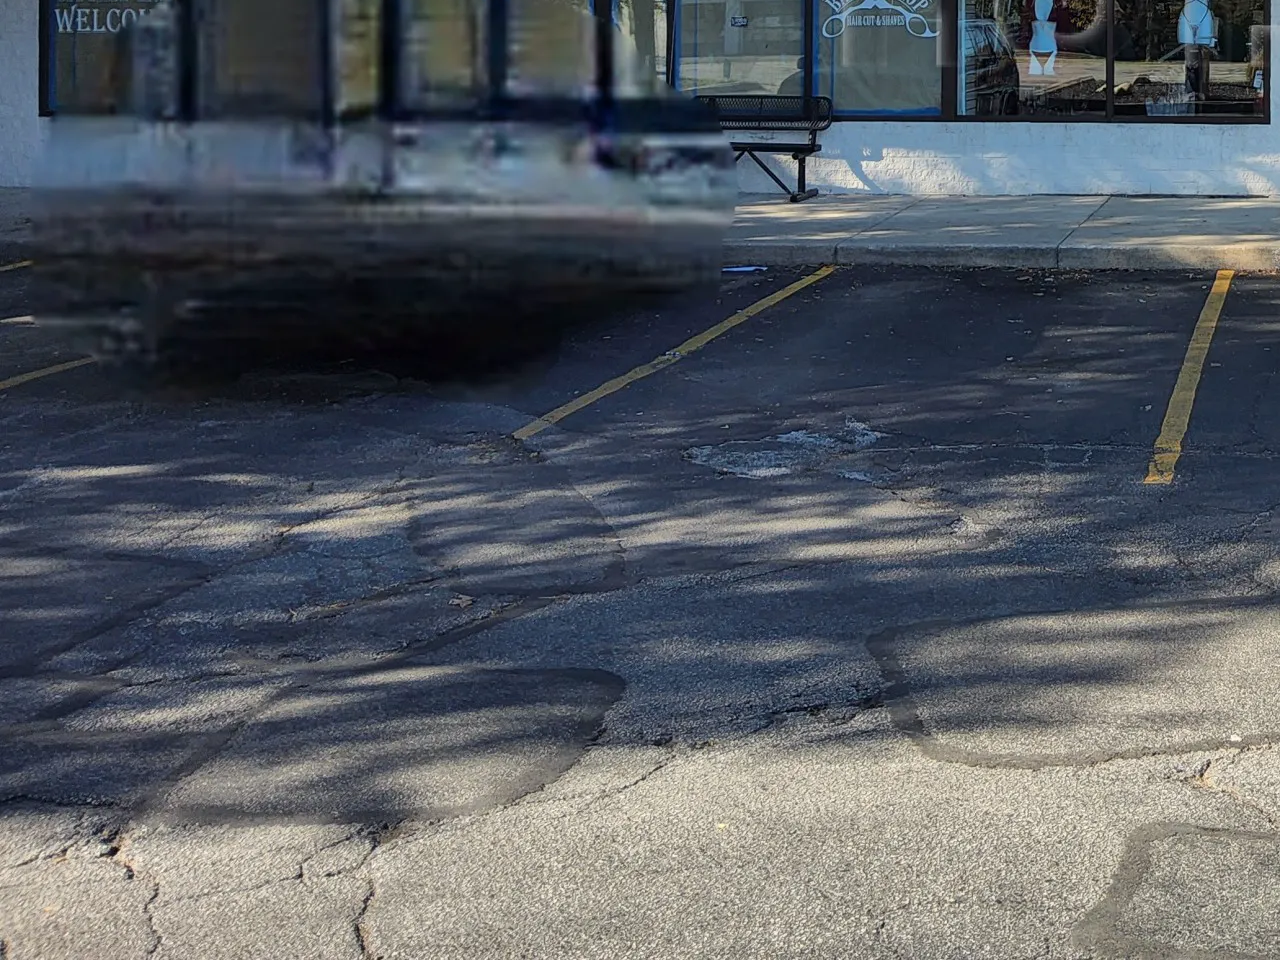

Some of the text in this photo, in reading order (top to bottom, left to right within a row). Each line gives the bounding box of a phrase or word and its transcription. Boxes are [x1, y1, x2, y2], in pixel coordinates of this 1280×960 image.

[54, 3, 150, 34] WELCO
[846, 15, 863, 27] HAIR
[863, 15, 875, 27] CUT
[881, 15, 905, 27] SHAVES
